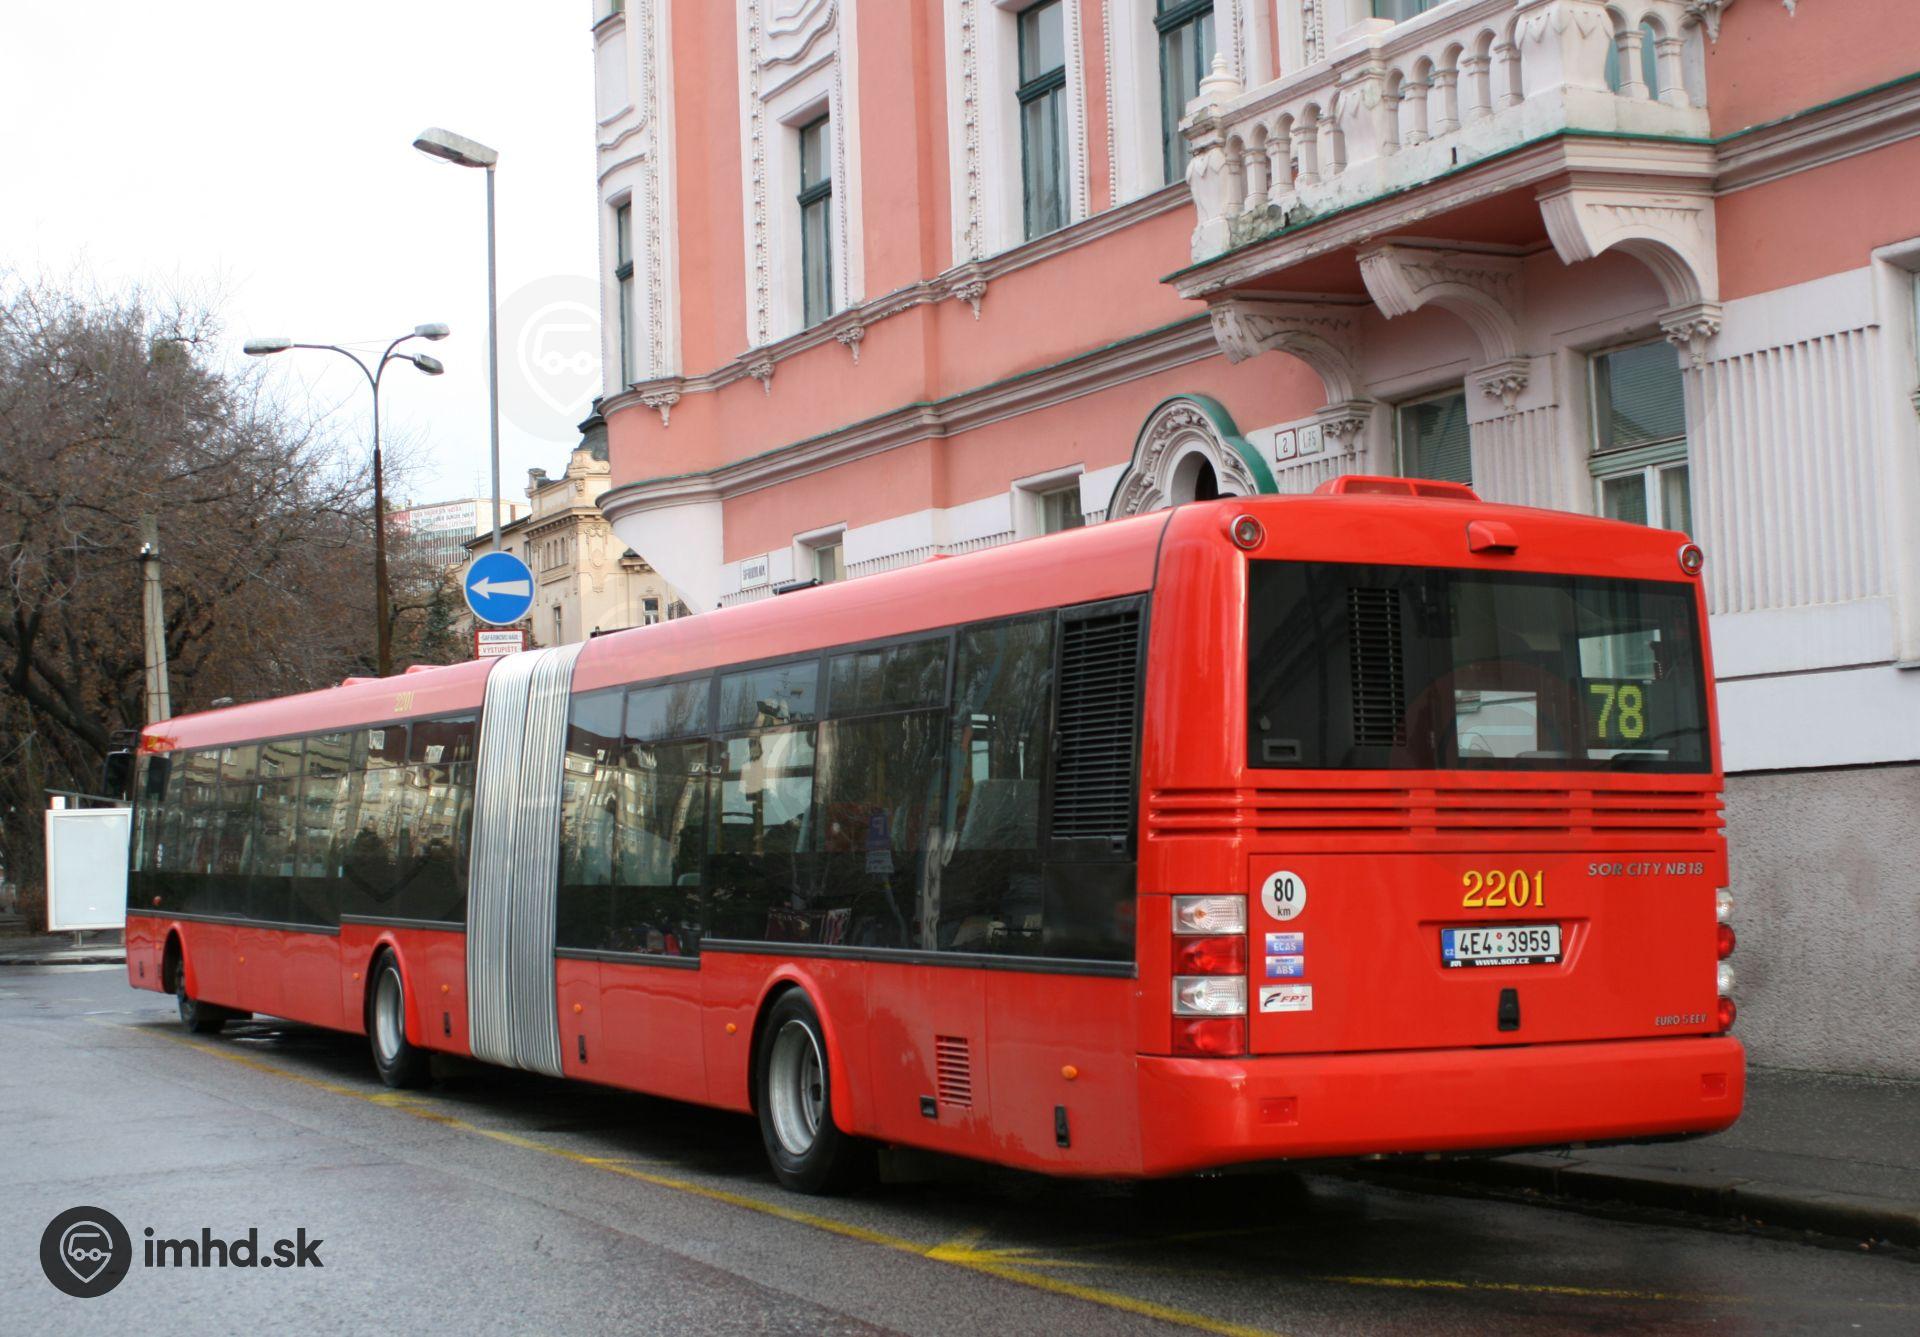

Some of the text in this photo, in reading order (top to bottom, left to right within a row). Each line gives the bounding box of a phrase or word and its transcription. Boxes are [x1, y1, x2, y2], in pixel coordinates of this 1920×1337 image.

[1282, 437, 1288, 454] 2
[1589, 684, 1644, 739] 78
[1588, 862, 1704, 876] SOR CITY NB18
[1274, 878, 1294, 902] 80
[1461, 869, 1545, 908] 2201
[1277, 905, 1291, 917] km
[1273, 942, 1297, 952] ECAS
[1459, 929, 1551, 956] 4E4 3959
[1445, 948, 1455, 956] CZ
[1475, 956, 1530, 967] www.sor.cz
[1275, 965, 1295, 975] ABS
[1280, 994, 1308, 1003] FPT
[1655, 1015, 1681, 1026] EURO
